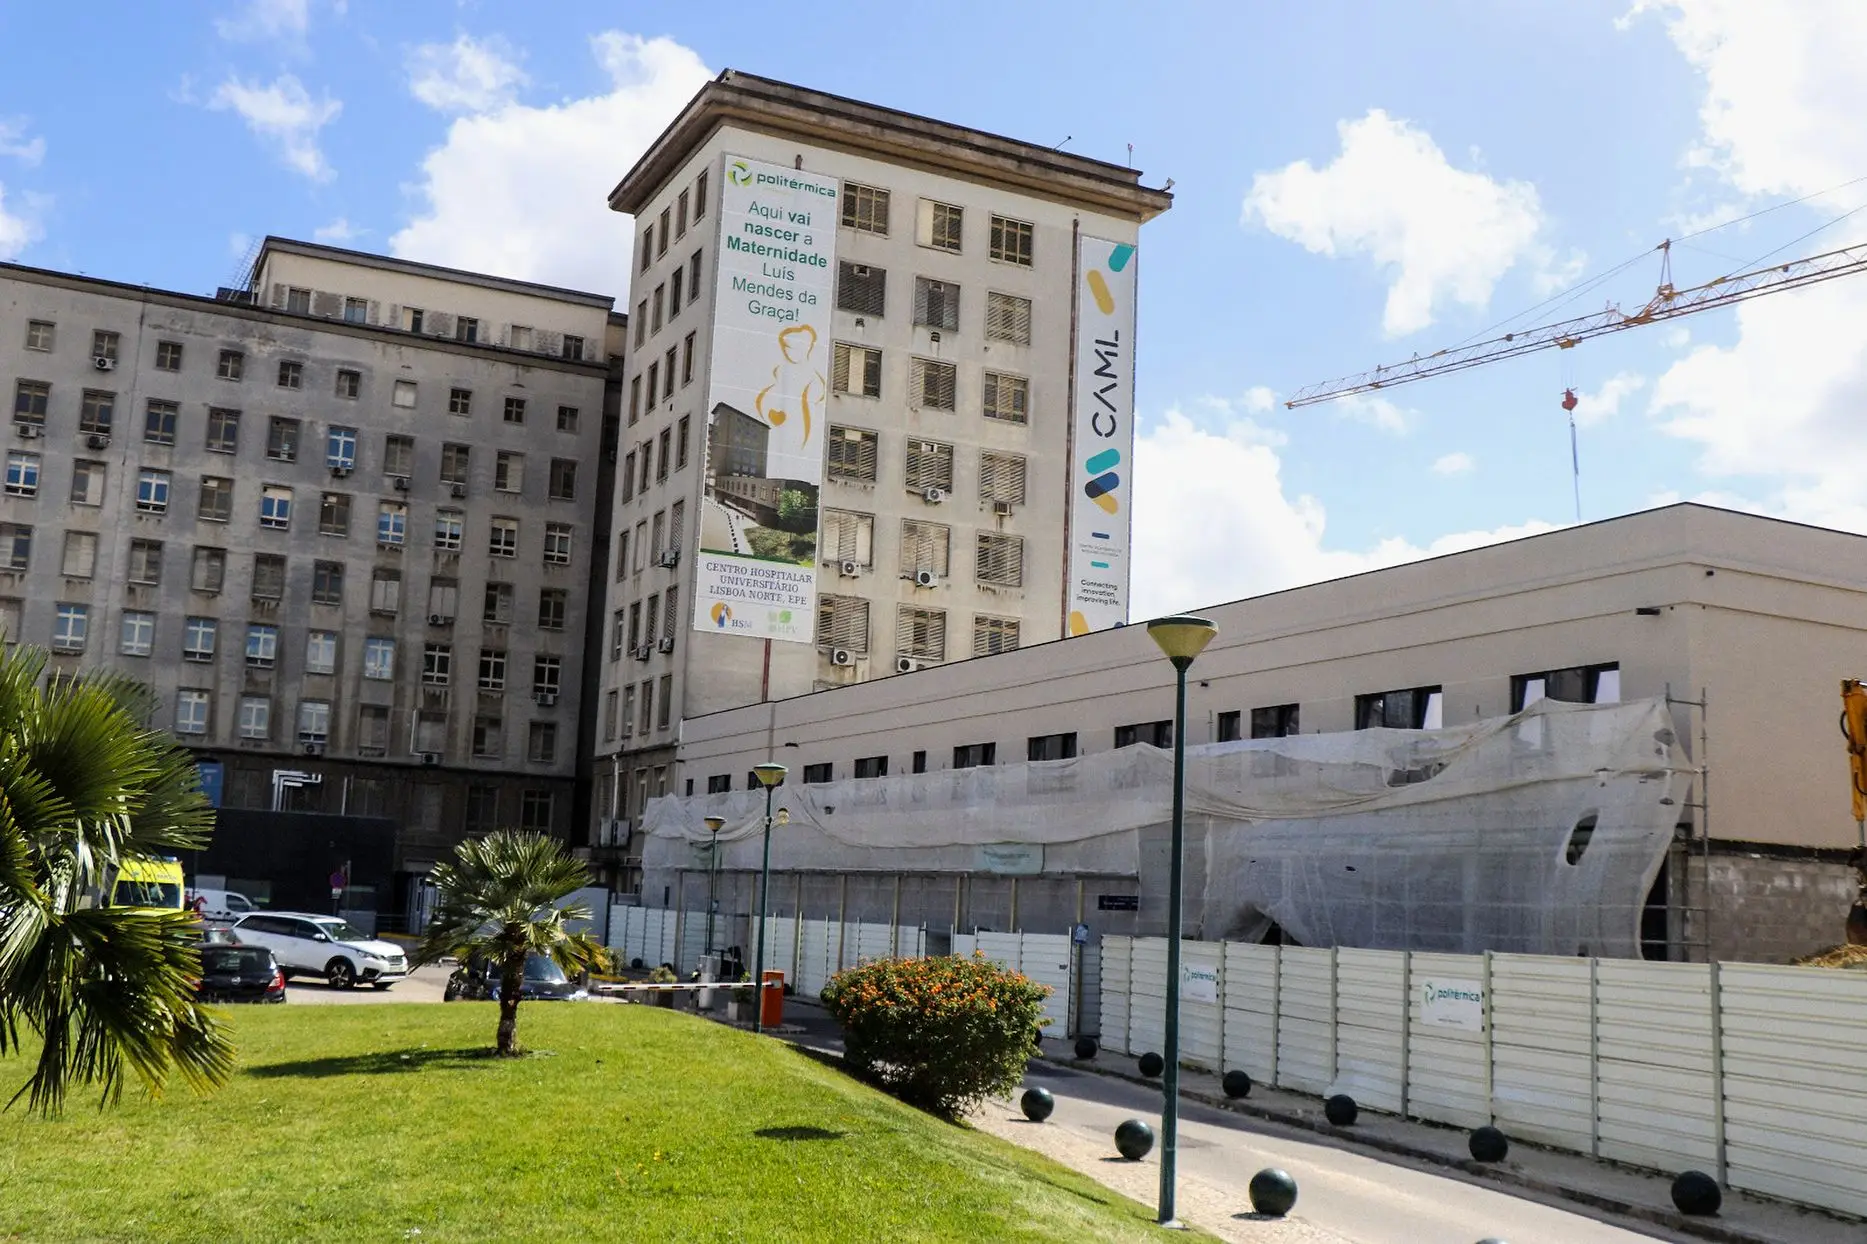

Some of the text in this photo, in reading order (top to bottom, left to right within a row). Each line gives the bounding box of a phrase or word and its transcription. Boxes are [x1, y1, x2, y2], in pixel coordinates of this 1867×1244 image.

[757, 172, 836, 198] politérmica
[748, 201, 811, 226] Aqui vai
[744, 222, 813, 245] nascer a
[727, 235, 828, 268] Maternidade
[763, 263, 795, 281] Luís
[732, 276, 817, 305] Mendes da
[748, 299, 800, 323] Graça!
[1092, 330, 1119, 438] CAML
[706, 562, 813, 584] CENTRO HOSPITALAR
[720, 575, 799, 593] UNIVERSITÁRIO
[709, 585, 807, 605] LISBOA NORTE, EPE
[1080, 579, 1118, 591] Connecting
